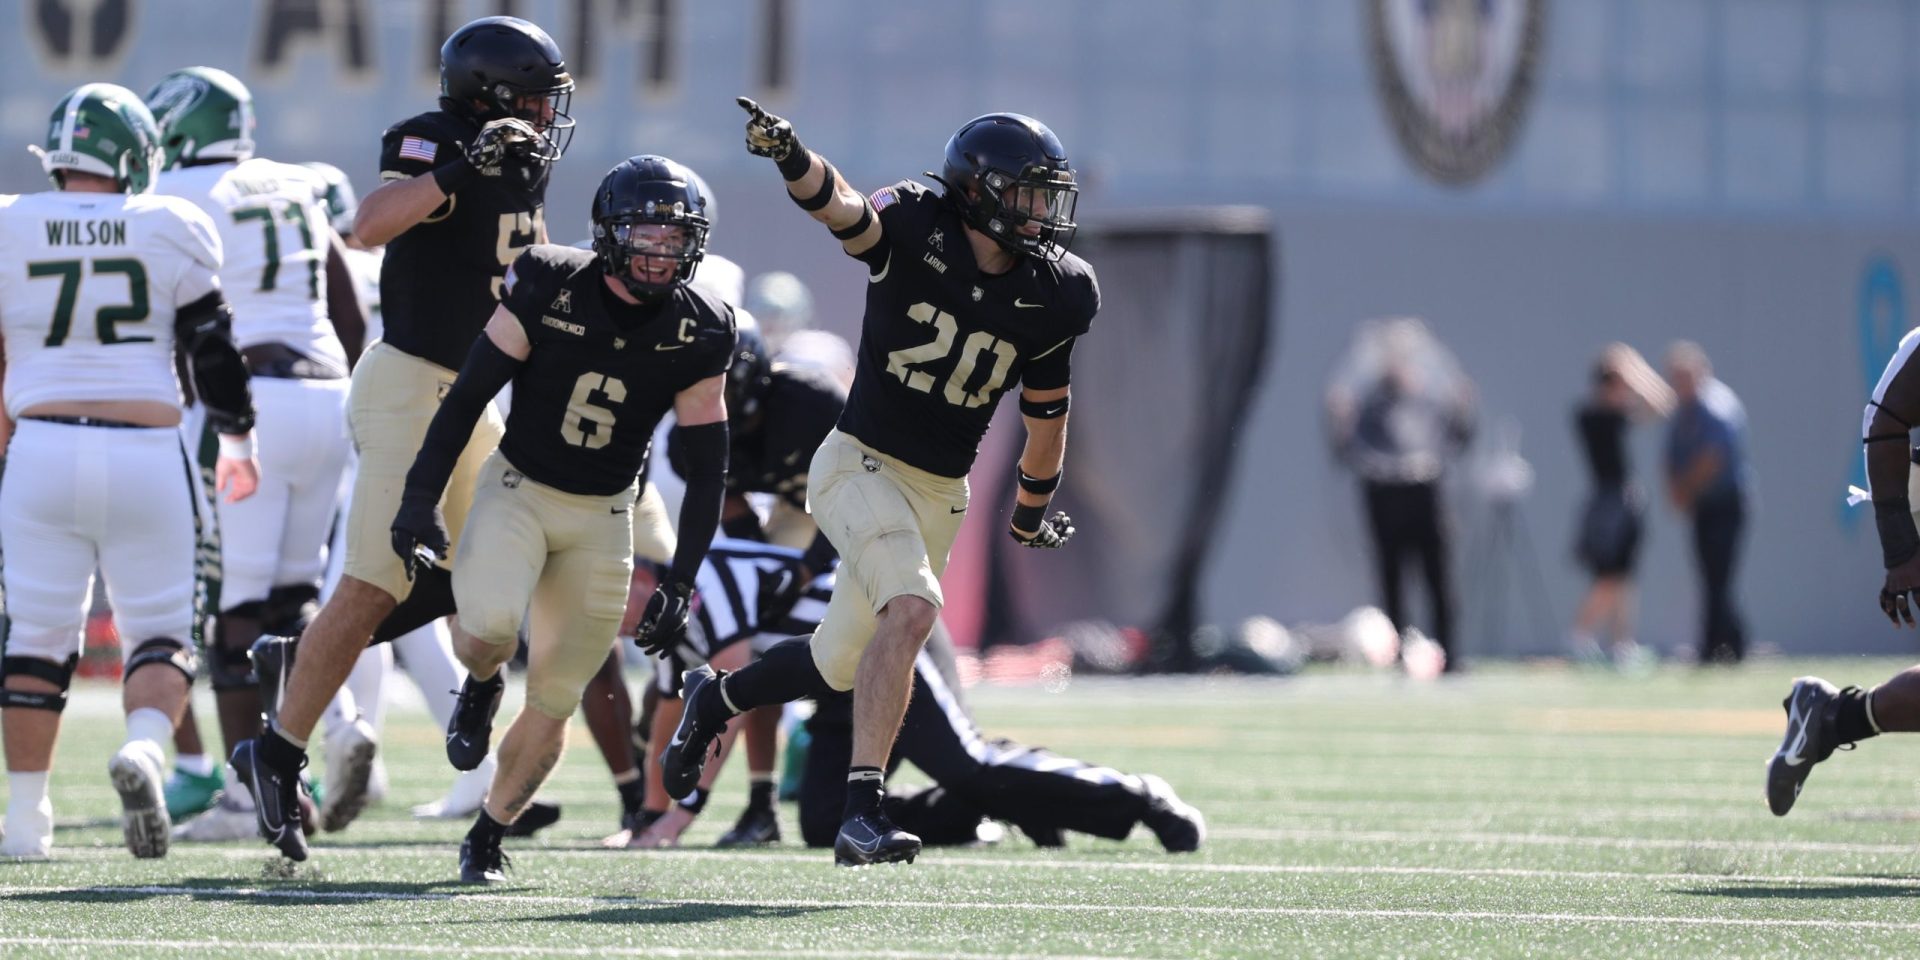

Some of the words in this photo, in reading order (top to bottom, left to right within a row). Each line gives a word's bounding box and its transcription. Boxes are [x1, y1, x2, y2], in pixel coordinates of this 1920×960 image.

[46, 221, 126, 246] WILSON
[490, 207, 544, 300] 5
[923, 251, 948, 274] LARKIN
[27, 257, 155, 347] 72
[677, 317, 697, 343] C
[886, 302, 1017, 408] 20
[560, 371, 627, 449] 6
